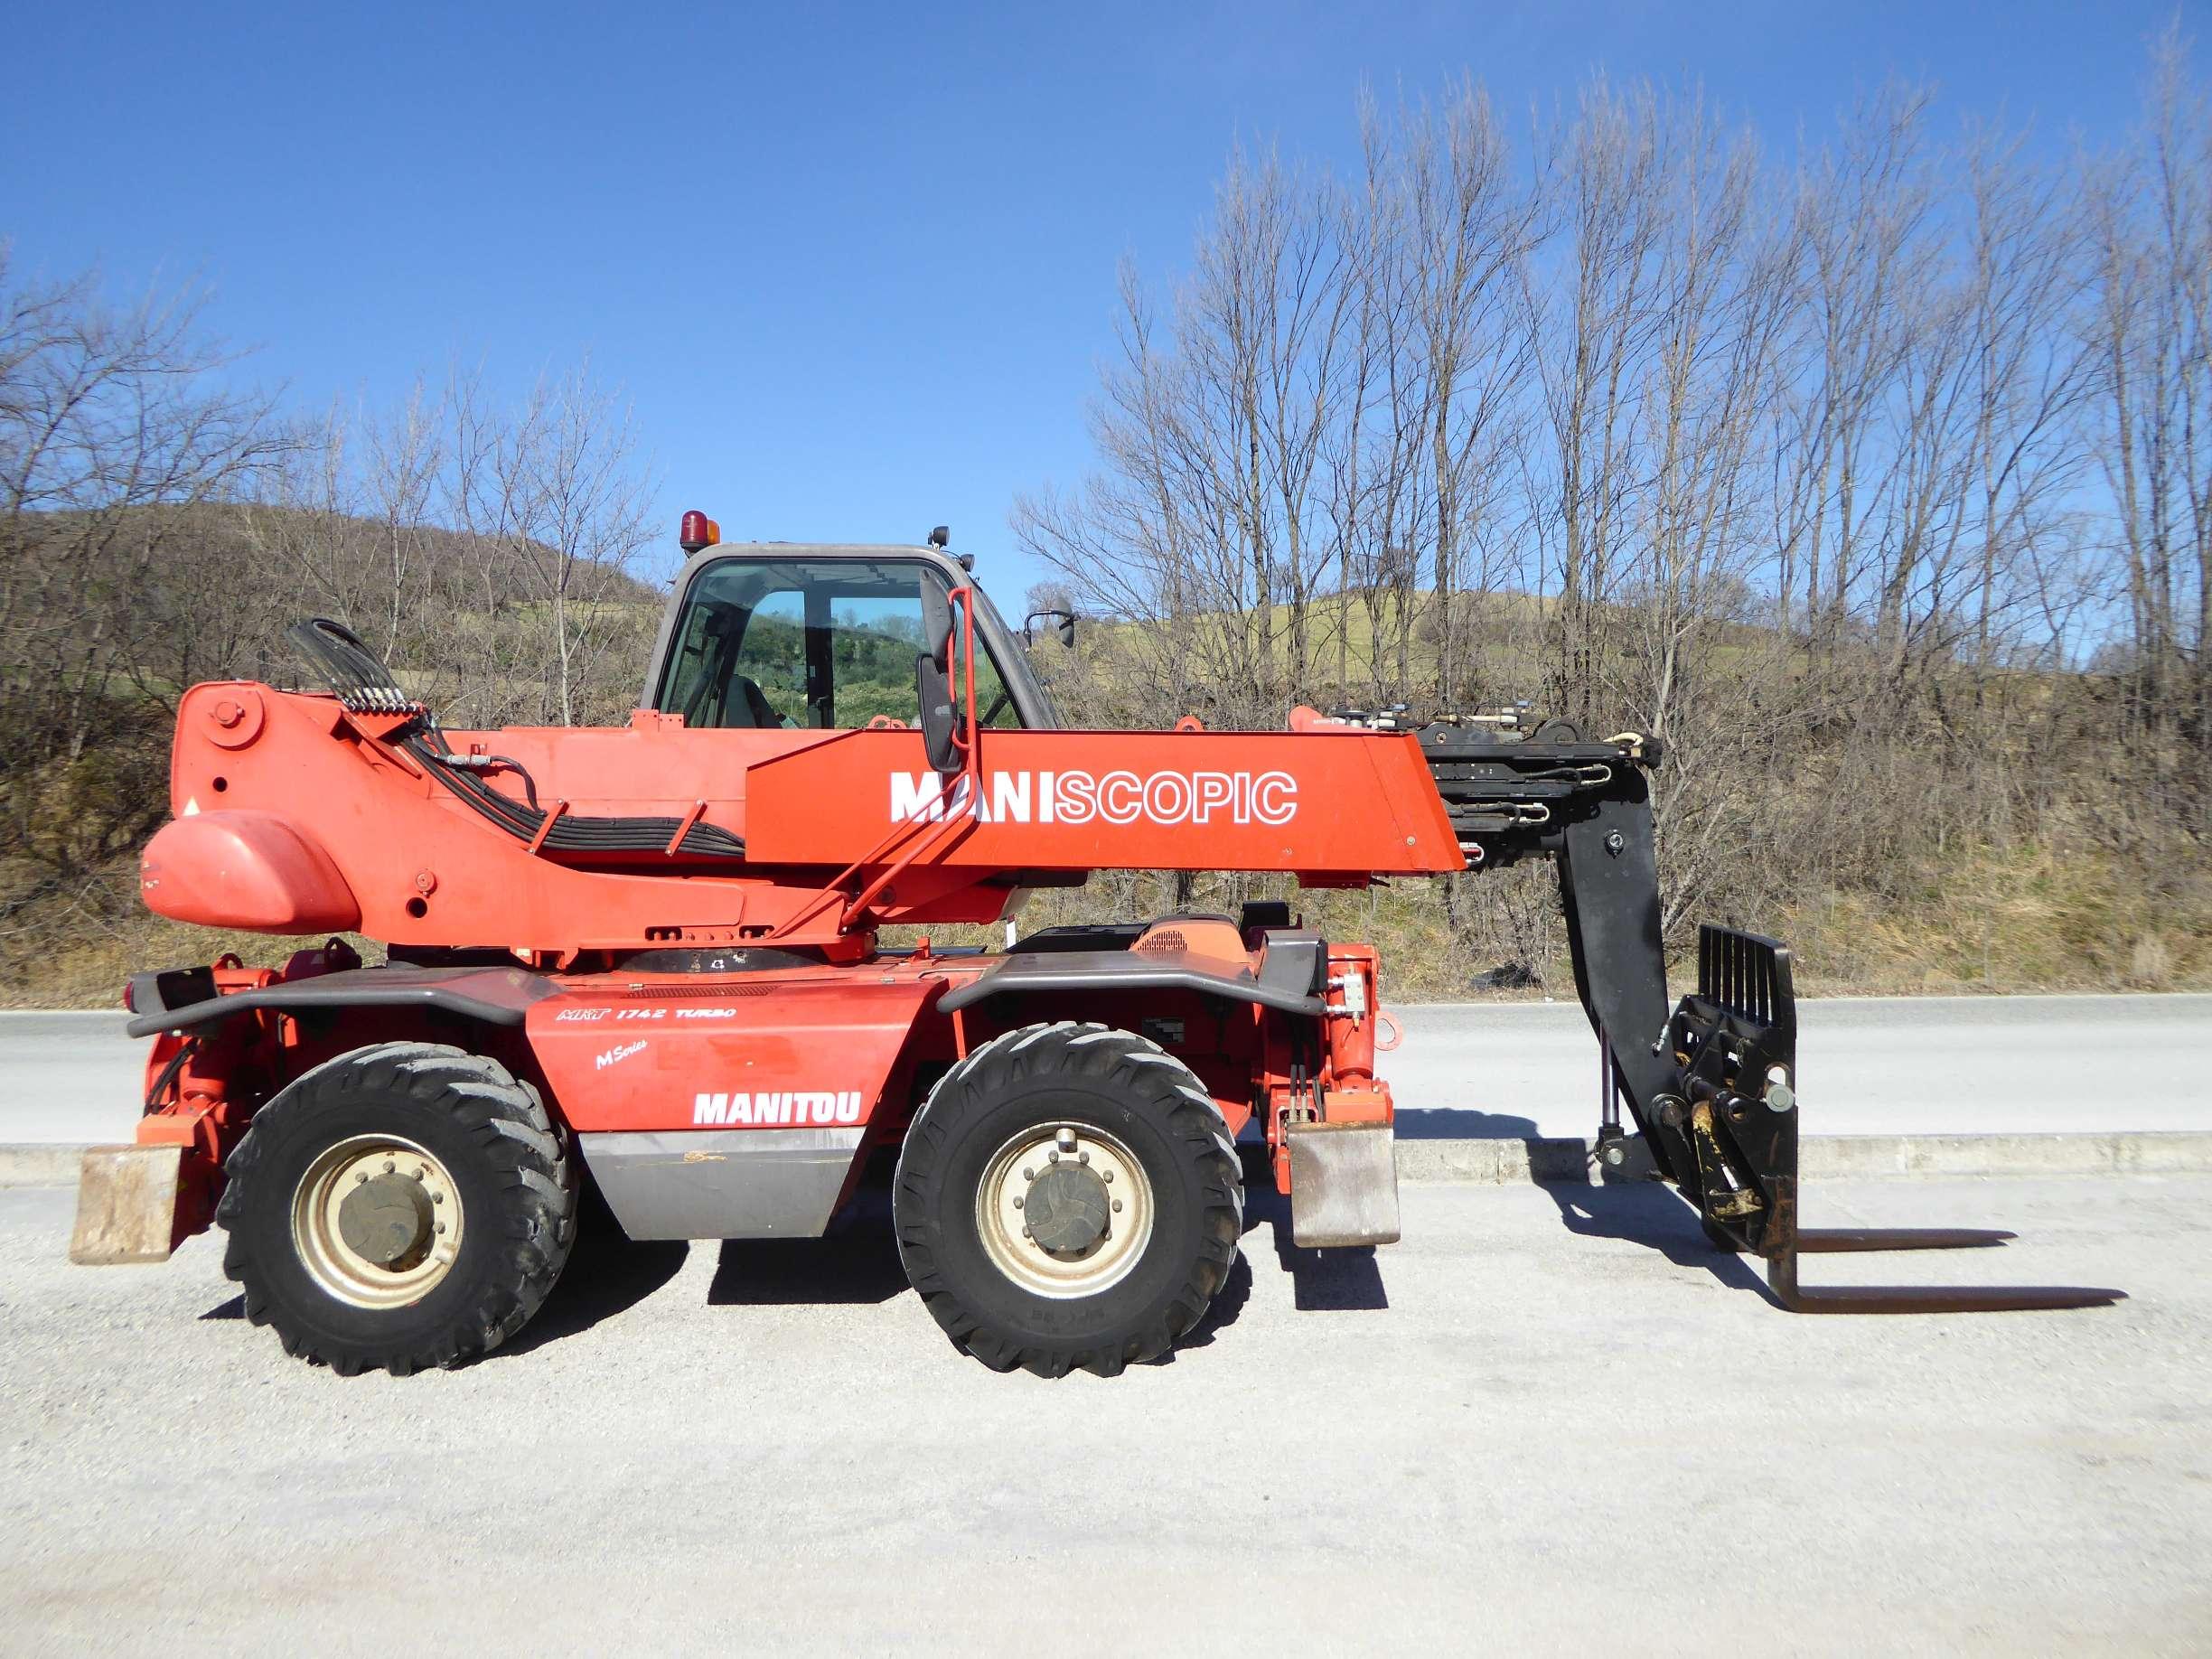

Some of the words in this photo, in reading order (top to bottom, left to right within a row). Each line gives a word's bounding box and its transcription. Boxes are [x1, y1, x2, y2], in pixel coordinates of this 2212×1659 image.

[890, 770, 1298, 825] MANISCOPIC
[556, 1008, 613, 1021] MRT
[616, 1008, 667, 1019] 1742
[675, 1008, 737, 1019] TURBO
[614, 1040, 648, 1062] Series
[693, 1092, 862, 1124] MANITOU
